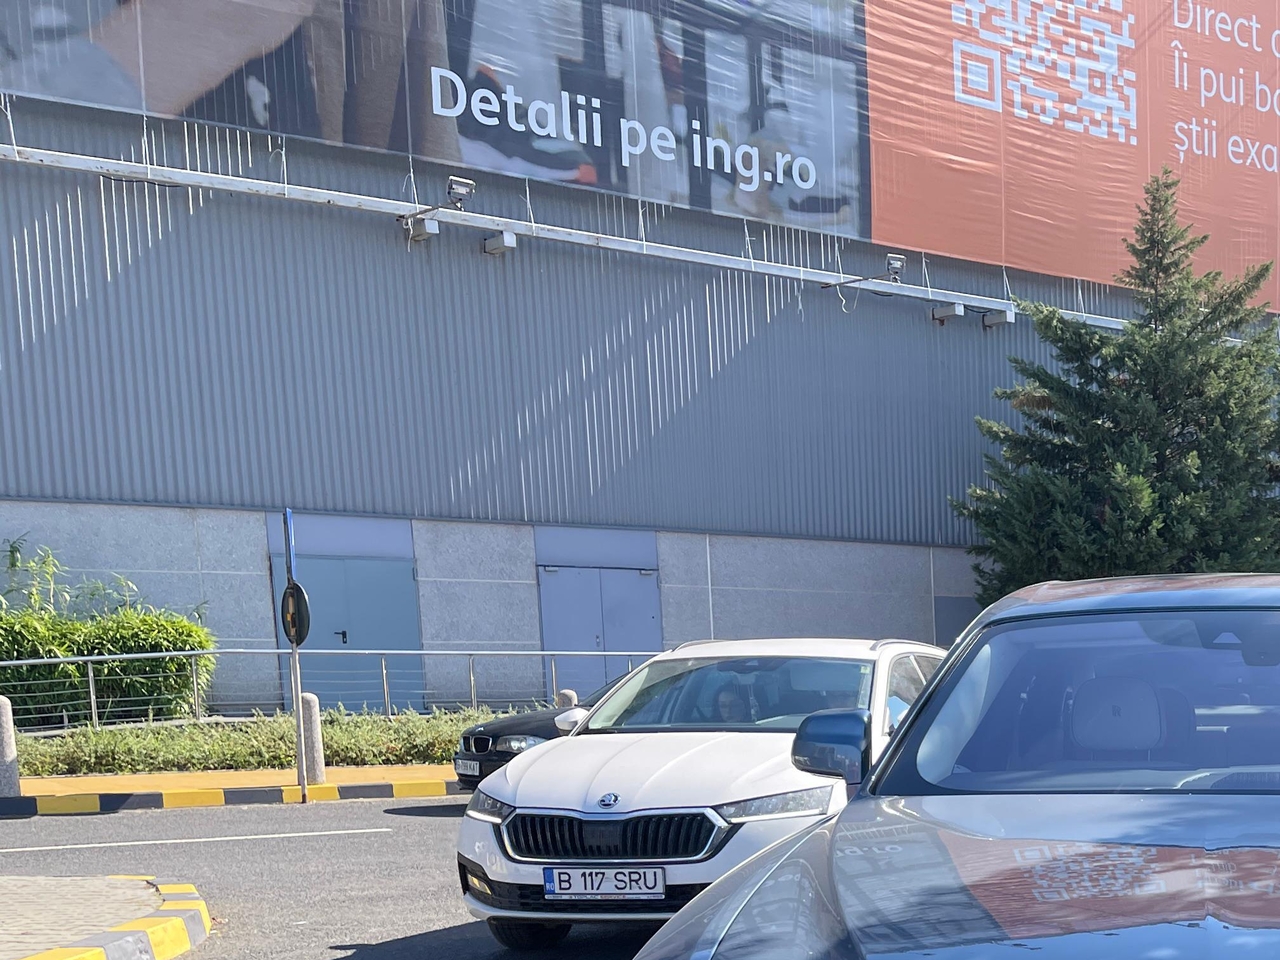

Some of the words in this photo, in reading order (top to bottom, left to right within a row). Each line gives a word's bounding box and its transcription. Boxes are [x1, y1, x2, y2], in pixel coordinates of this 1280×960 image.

[1173, 0, 1262, 51] Direct
[1170, 39, 1188, 91] Îi
[1201, 68, 1244, 107] pui
[430, 66, 602, 148] Detalii
[620, 117, 677, 167] pe
[692, 120, 817, 192] ing.ro
[1174, 117, 1217, 163] știi
[558, 871, 572, 891] B
[581, 871, 606, 891] 117
[614, 871, 657, 891] SRU
